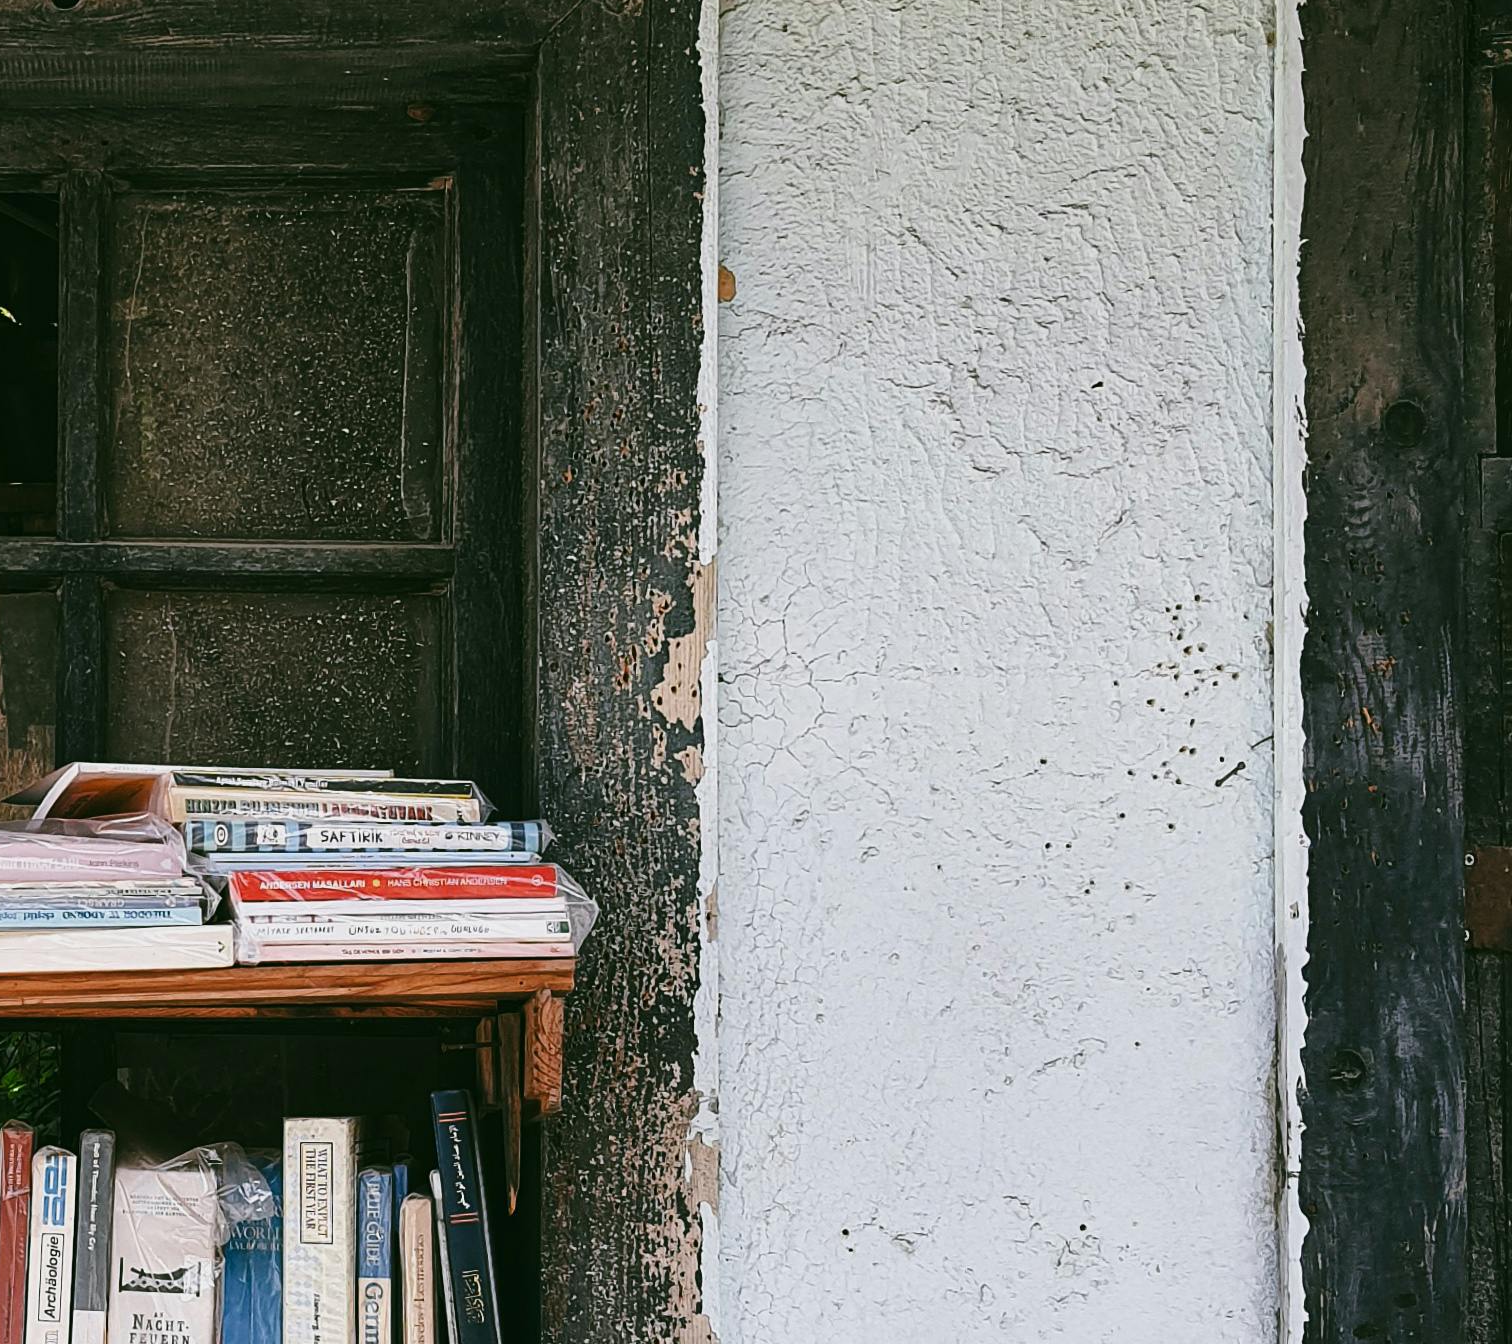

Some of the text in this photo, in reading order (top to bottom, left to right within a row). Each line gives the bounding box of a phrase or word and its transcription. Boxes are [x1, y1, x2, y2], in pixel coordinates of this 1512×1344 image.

[321, 830, 383, 844] SAFTİRİK
[312, 879, 366, 889] MASALLARI
[388, 879, 411, 887] HANS
[304, 1148, 317, 1230] THE FIRST YEAR
[316, 1148, 329, 1239] WHAT TO EXPECT
[86, 1238, 97, 1251] Cry
[43, 1236, 61, 1319] Archäologie
[132, 1313, 190, 1332] NACHT-
